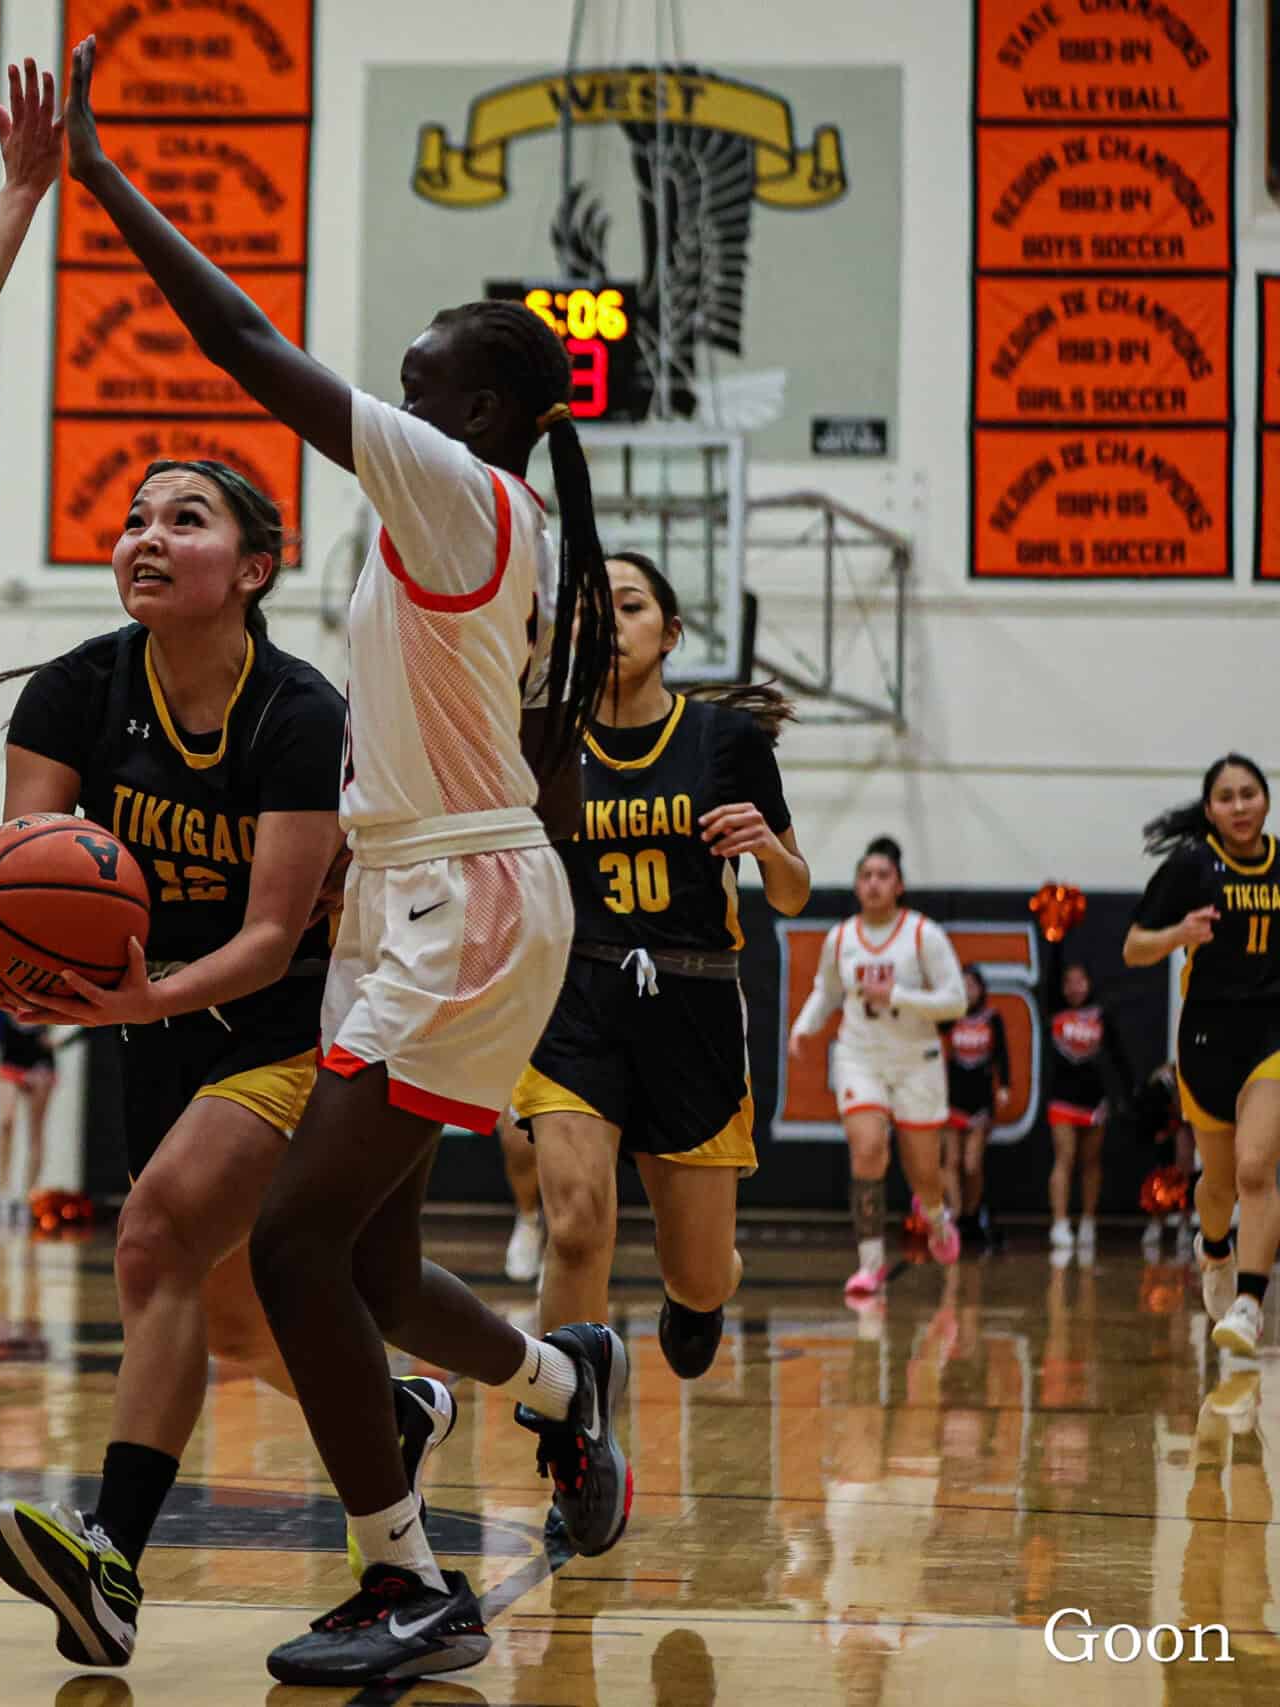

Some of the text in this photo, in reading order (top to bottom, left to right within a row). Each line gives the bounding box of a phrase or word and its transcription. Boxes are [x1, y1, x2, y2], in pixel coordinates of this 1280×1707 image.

[997, 3, 1061, 69] STATE
[1023, 86, 1182, 111] VOLLEYBALL
[1097, 135, 1216, 230] CHAMPIONS
[1022, 234, 1186, 259] BOYS SOCCER
[1096, 286, 1215, 383] CHAMPIONS
[1017, 385, 1188, 412] GIRLS SOCCER
[1095, 440, 1215, 535] CHAMPIONS
[1016, 538, 1187, 565] GIRLS SOCCER
[573, 793, 693, 843] IKIGAQ
[153, 858, 228, 902] 12
[598, 848, 670, 915] 30
[1247, 914, 1271, 955] 11
